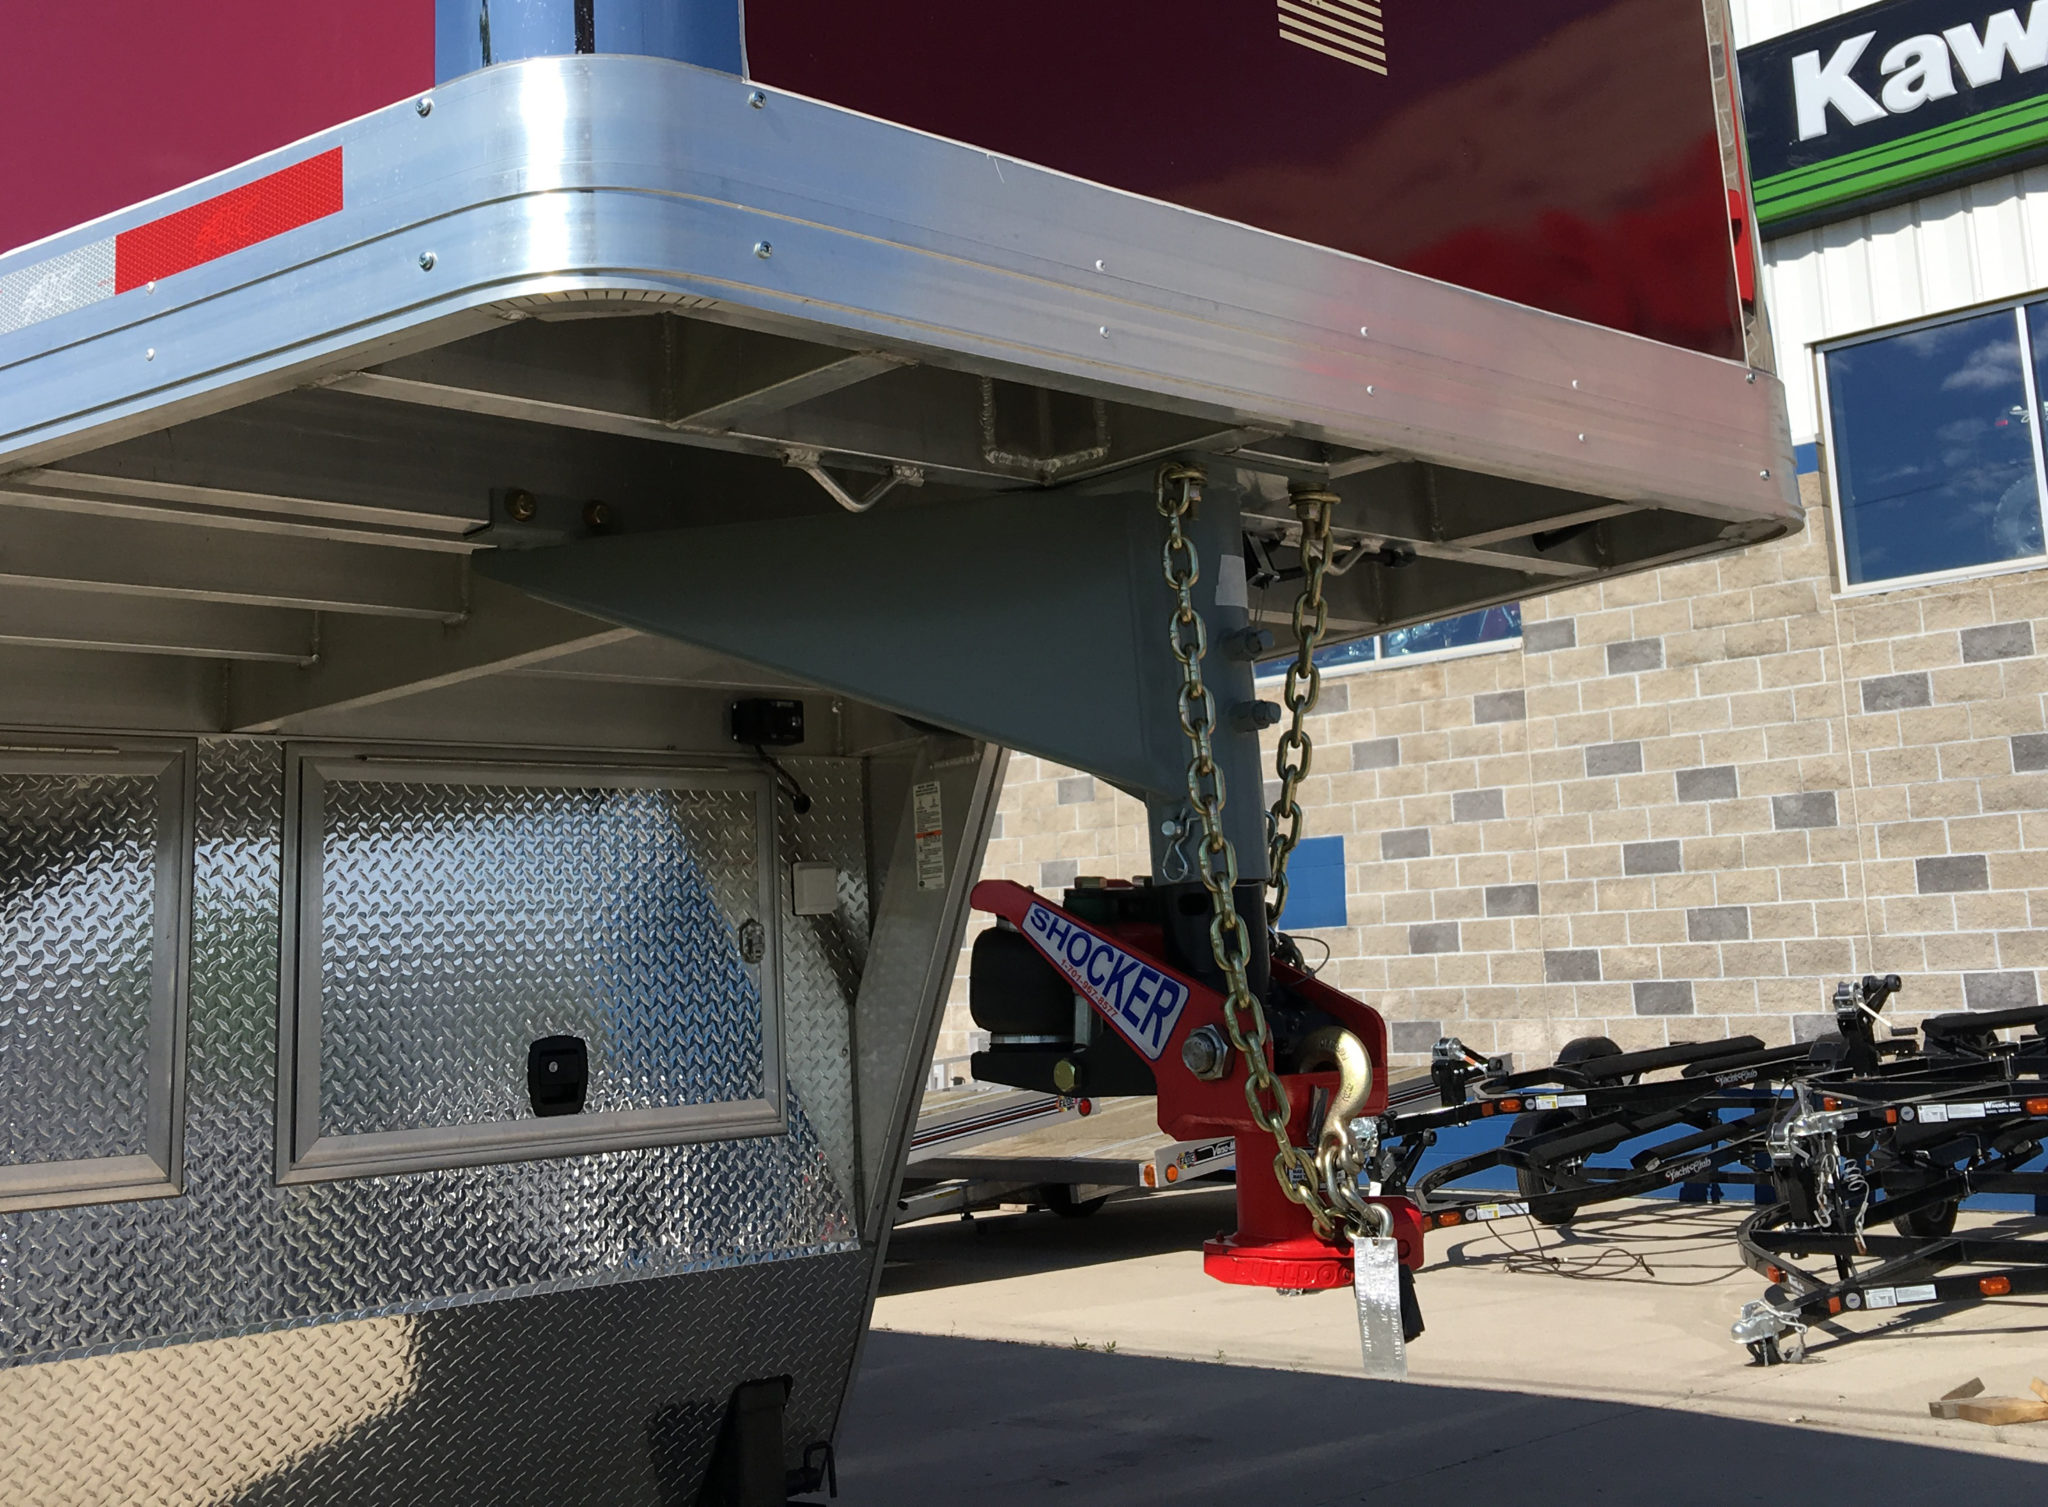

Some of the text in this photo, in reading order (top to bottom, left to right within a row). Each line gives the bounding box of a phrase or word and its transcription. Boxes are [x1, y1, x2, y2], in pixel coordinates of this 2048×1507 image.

[1791, 0, 2048, 141] Kaw
[1030, 907, 1180, 1048] SHOCKER
[1060, 957, 1119, 1018] 1-701-967-8577
